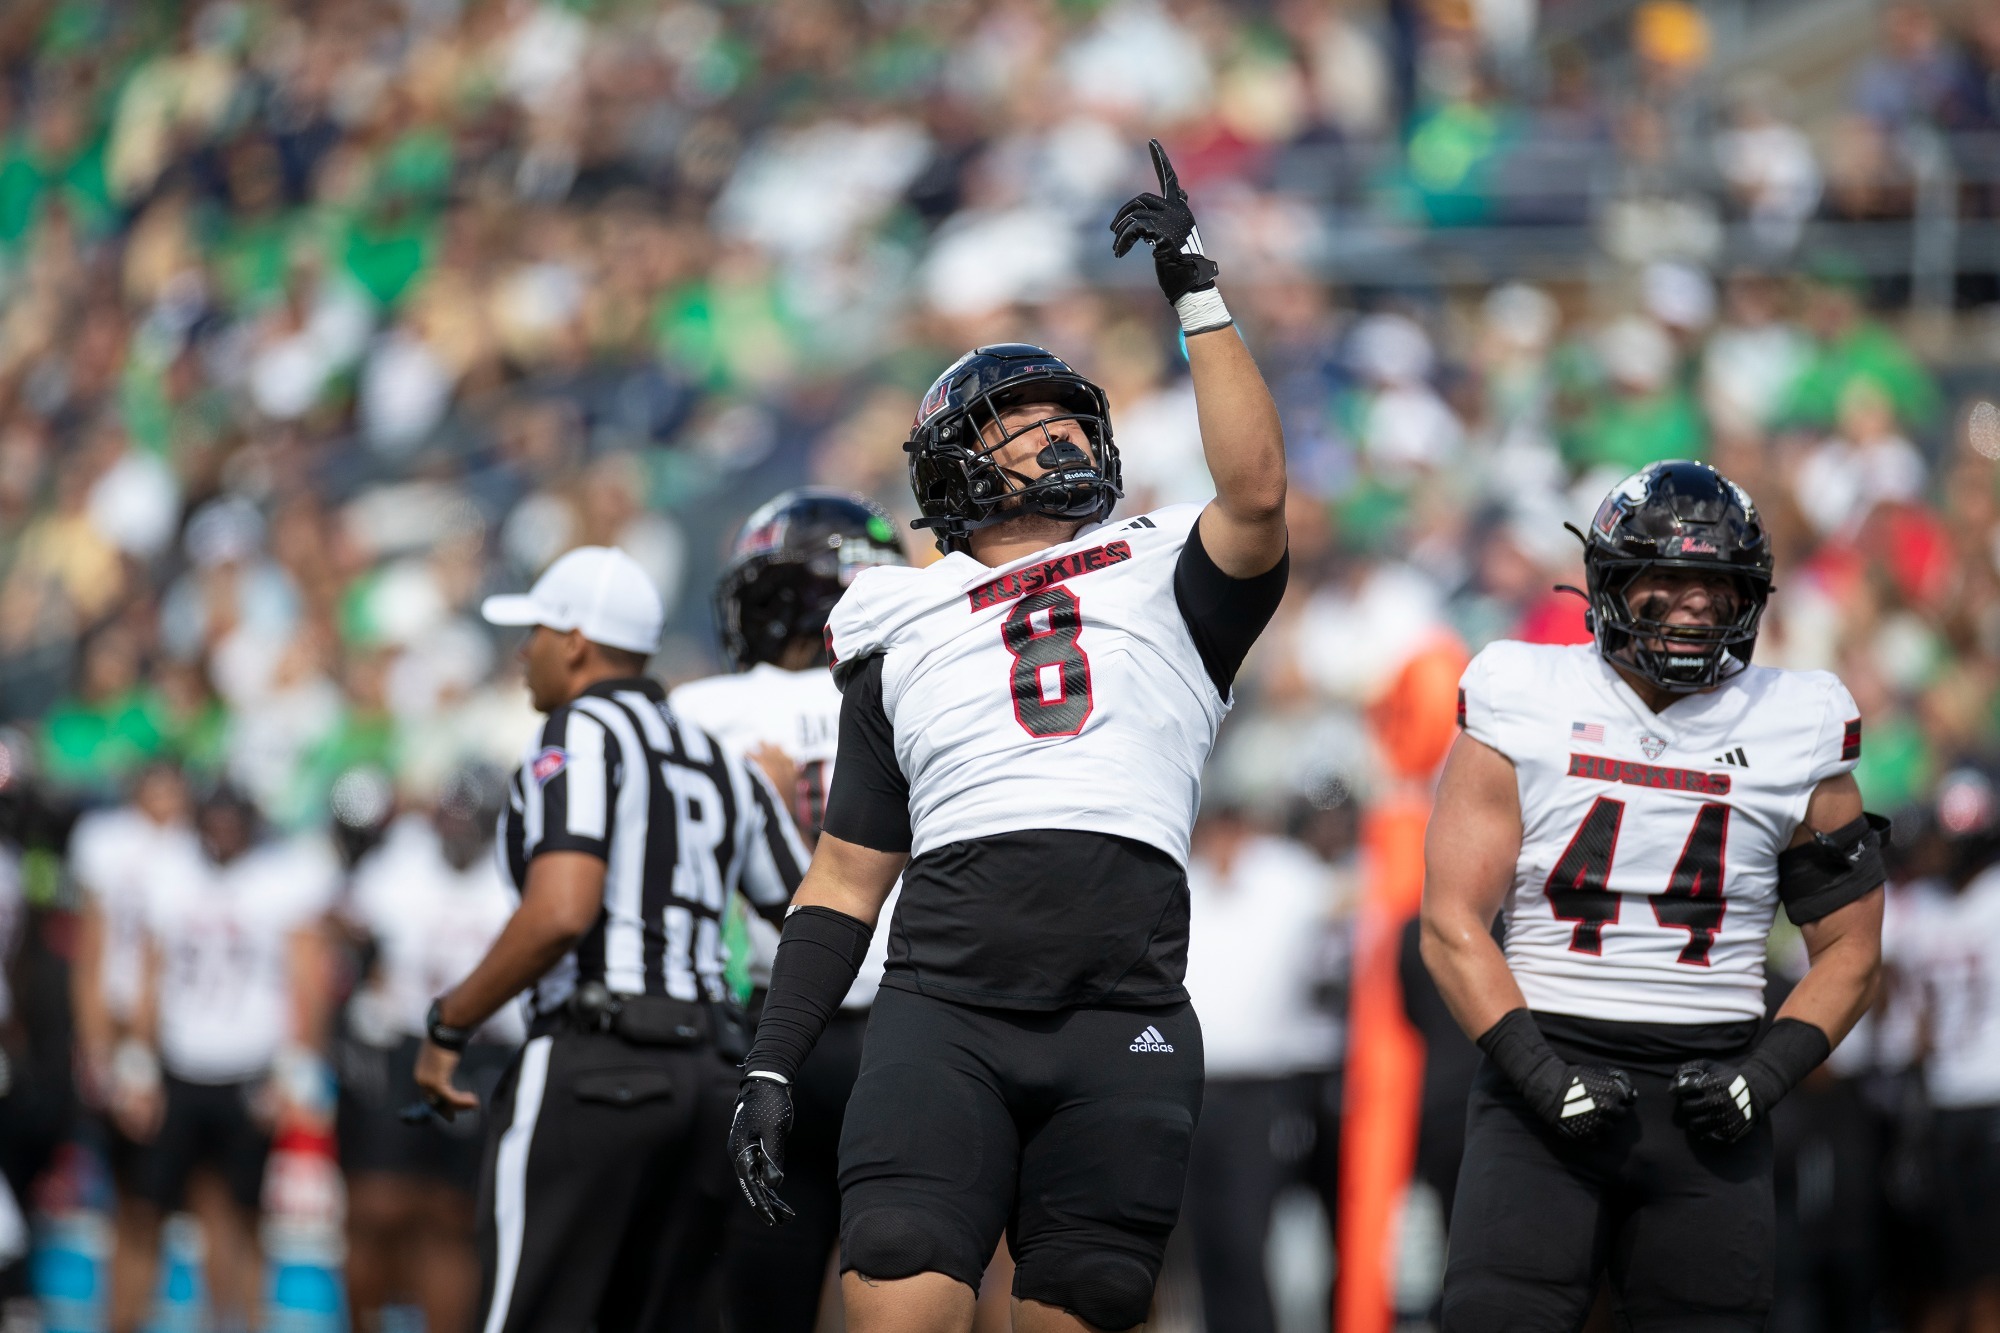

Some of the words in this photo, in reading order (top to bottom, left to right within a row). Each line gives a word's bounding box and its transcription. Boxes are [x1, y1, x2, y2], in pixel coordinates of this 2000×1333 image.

[1063, 471, 1094, 480] Riddell
[968, 540, 1132, 613] HUSKIES
[1001, 584, 1094, 738] 8
[1567, 753, 1731, 796] HUSKIES
[659, 759, 728, 912] R
[1543, 796, 1730, 967] 44
[1129, 1042, 1174, 1053] adidas
[739, 1177, 757, 1207] ADIZERO
